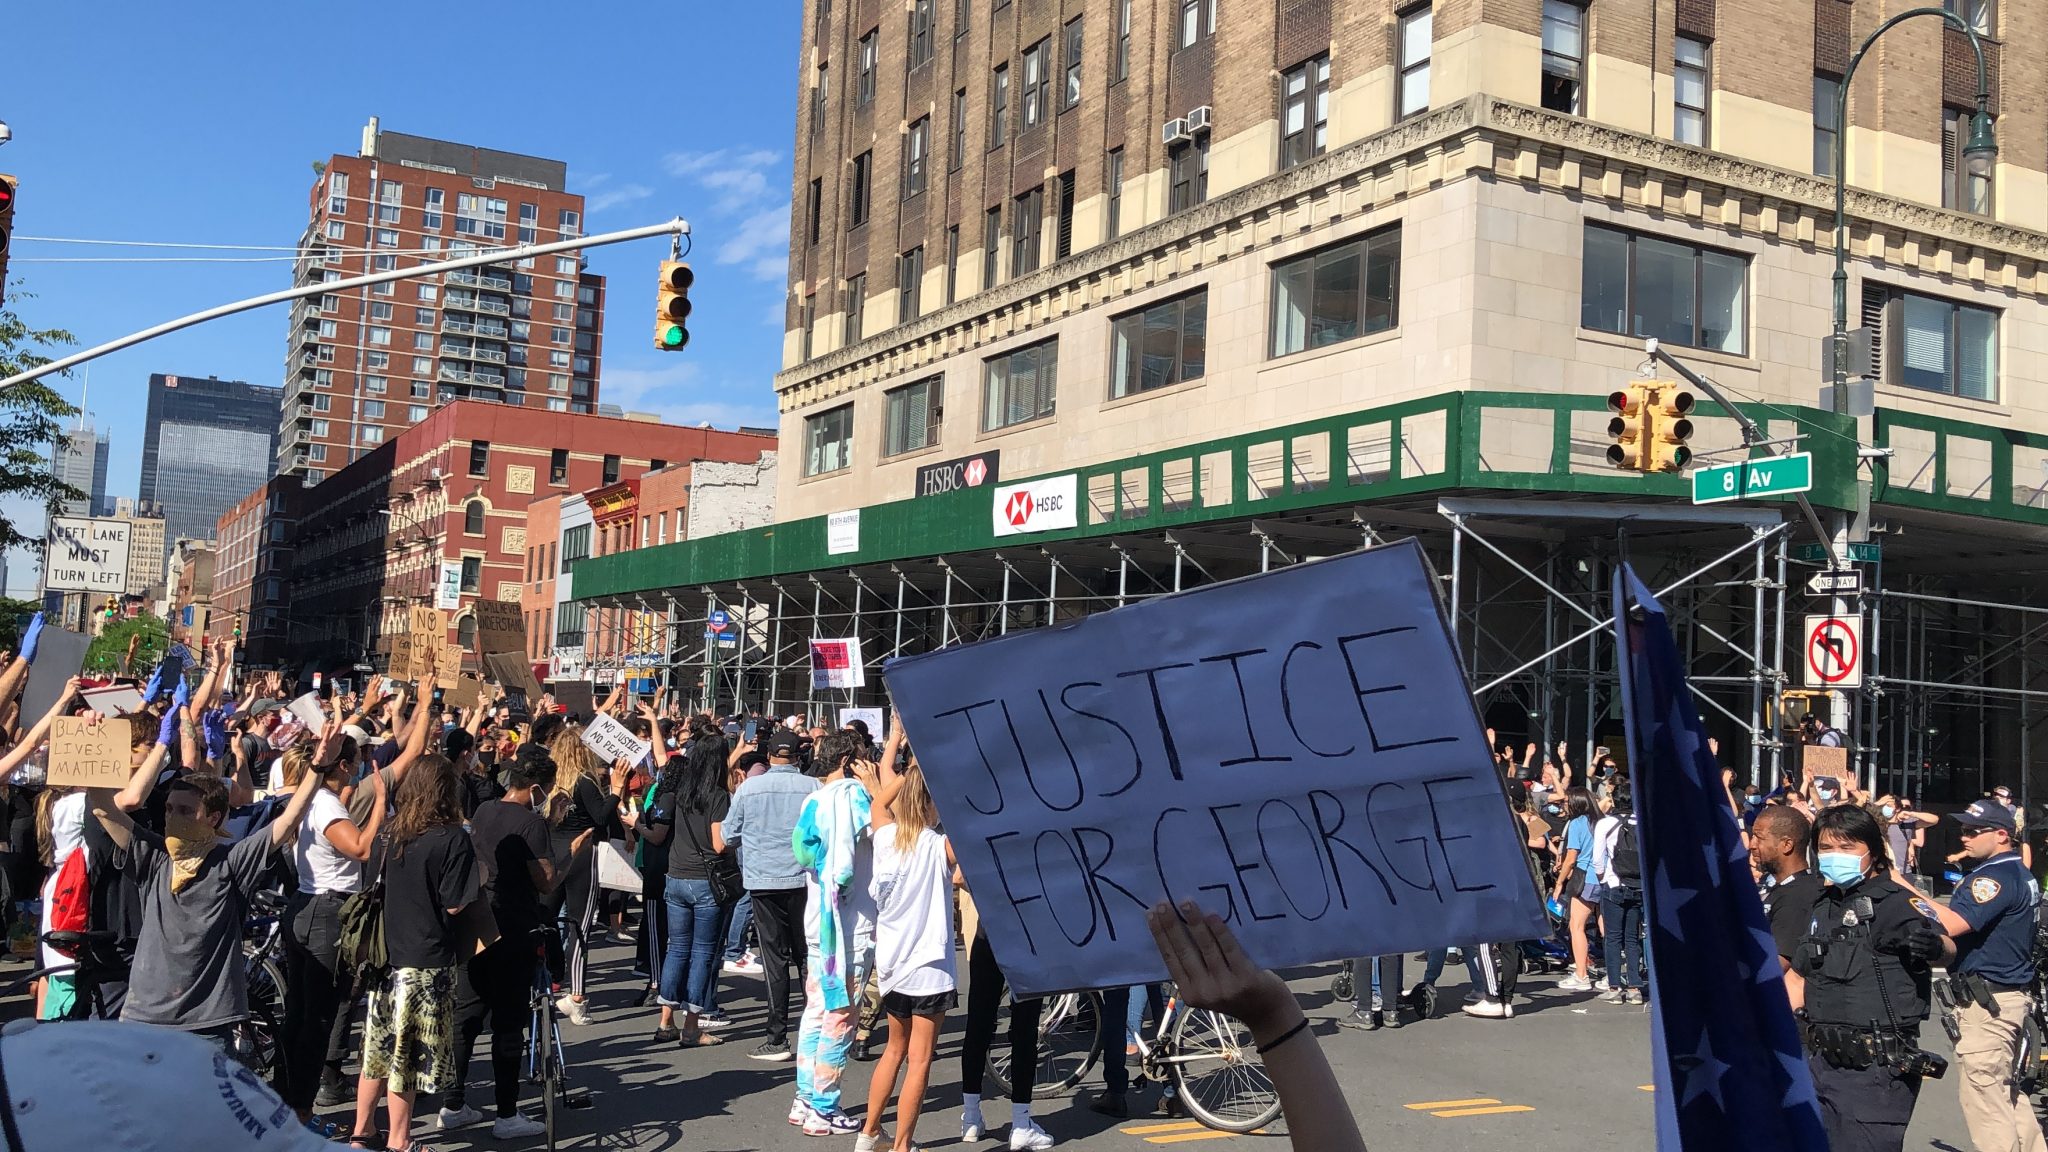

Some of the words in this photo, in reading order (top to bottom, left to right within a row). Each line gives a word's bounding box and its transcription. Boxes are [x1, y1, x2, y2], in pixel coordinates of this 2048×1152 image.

[922, 462, 964, 496] HSBC
[1723, 471, 1734, 492] 8
[1748, 468, 1773, 489] Av
[1036, 495, 1063, 513] HSBC
[56, 526, 86, 539] LEFT
[93, 529, 124, 541] LANE
[68, 547, 109, 563] MUST
[1860, 546, 1868, 559] 14
[54, 569, 85, 582] TURN
[92, 572, 120, 584] LEFT
[1815, 578, 1832, 588] ONE
[1836, 577, 1853, 587] WAY
[417, 610, 436, 631] NO
[55, 719, 107, 739] BLACK
[933, 625, 1460, 816] JUSTICE
[590, 731, 603, 743] NO
[600, 720, 615, 733] NO
[613, 731, 643, 754] JUSTICE
[54, 743, 103, 755] LIVES
[54, 759, 122, 778] MATTER
[985, 826, 1151, 957] FOR
[1153, 776, 1497, 927] GEORGE
[218, 1081, 267, 1140] ANNUAL
